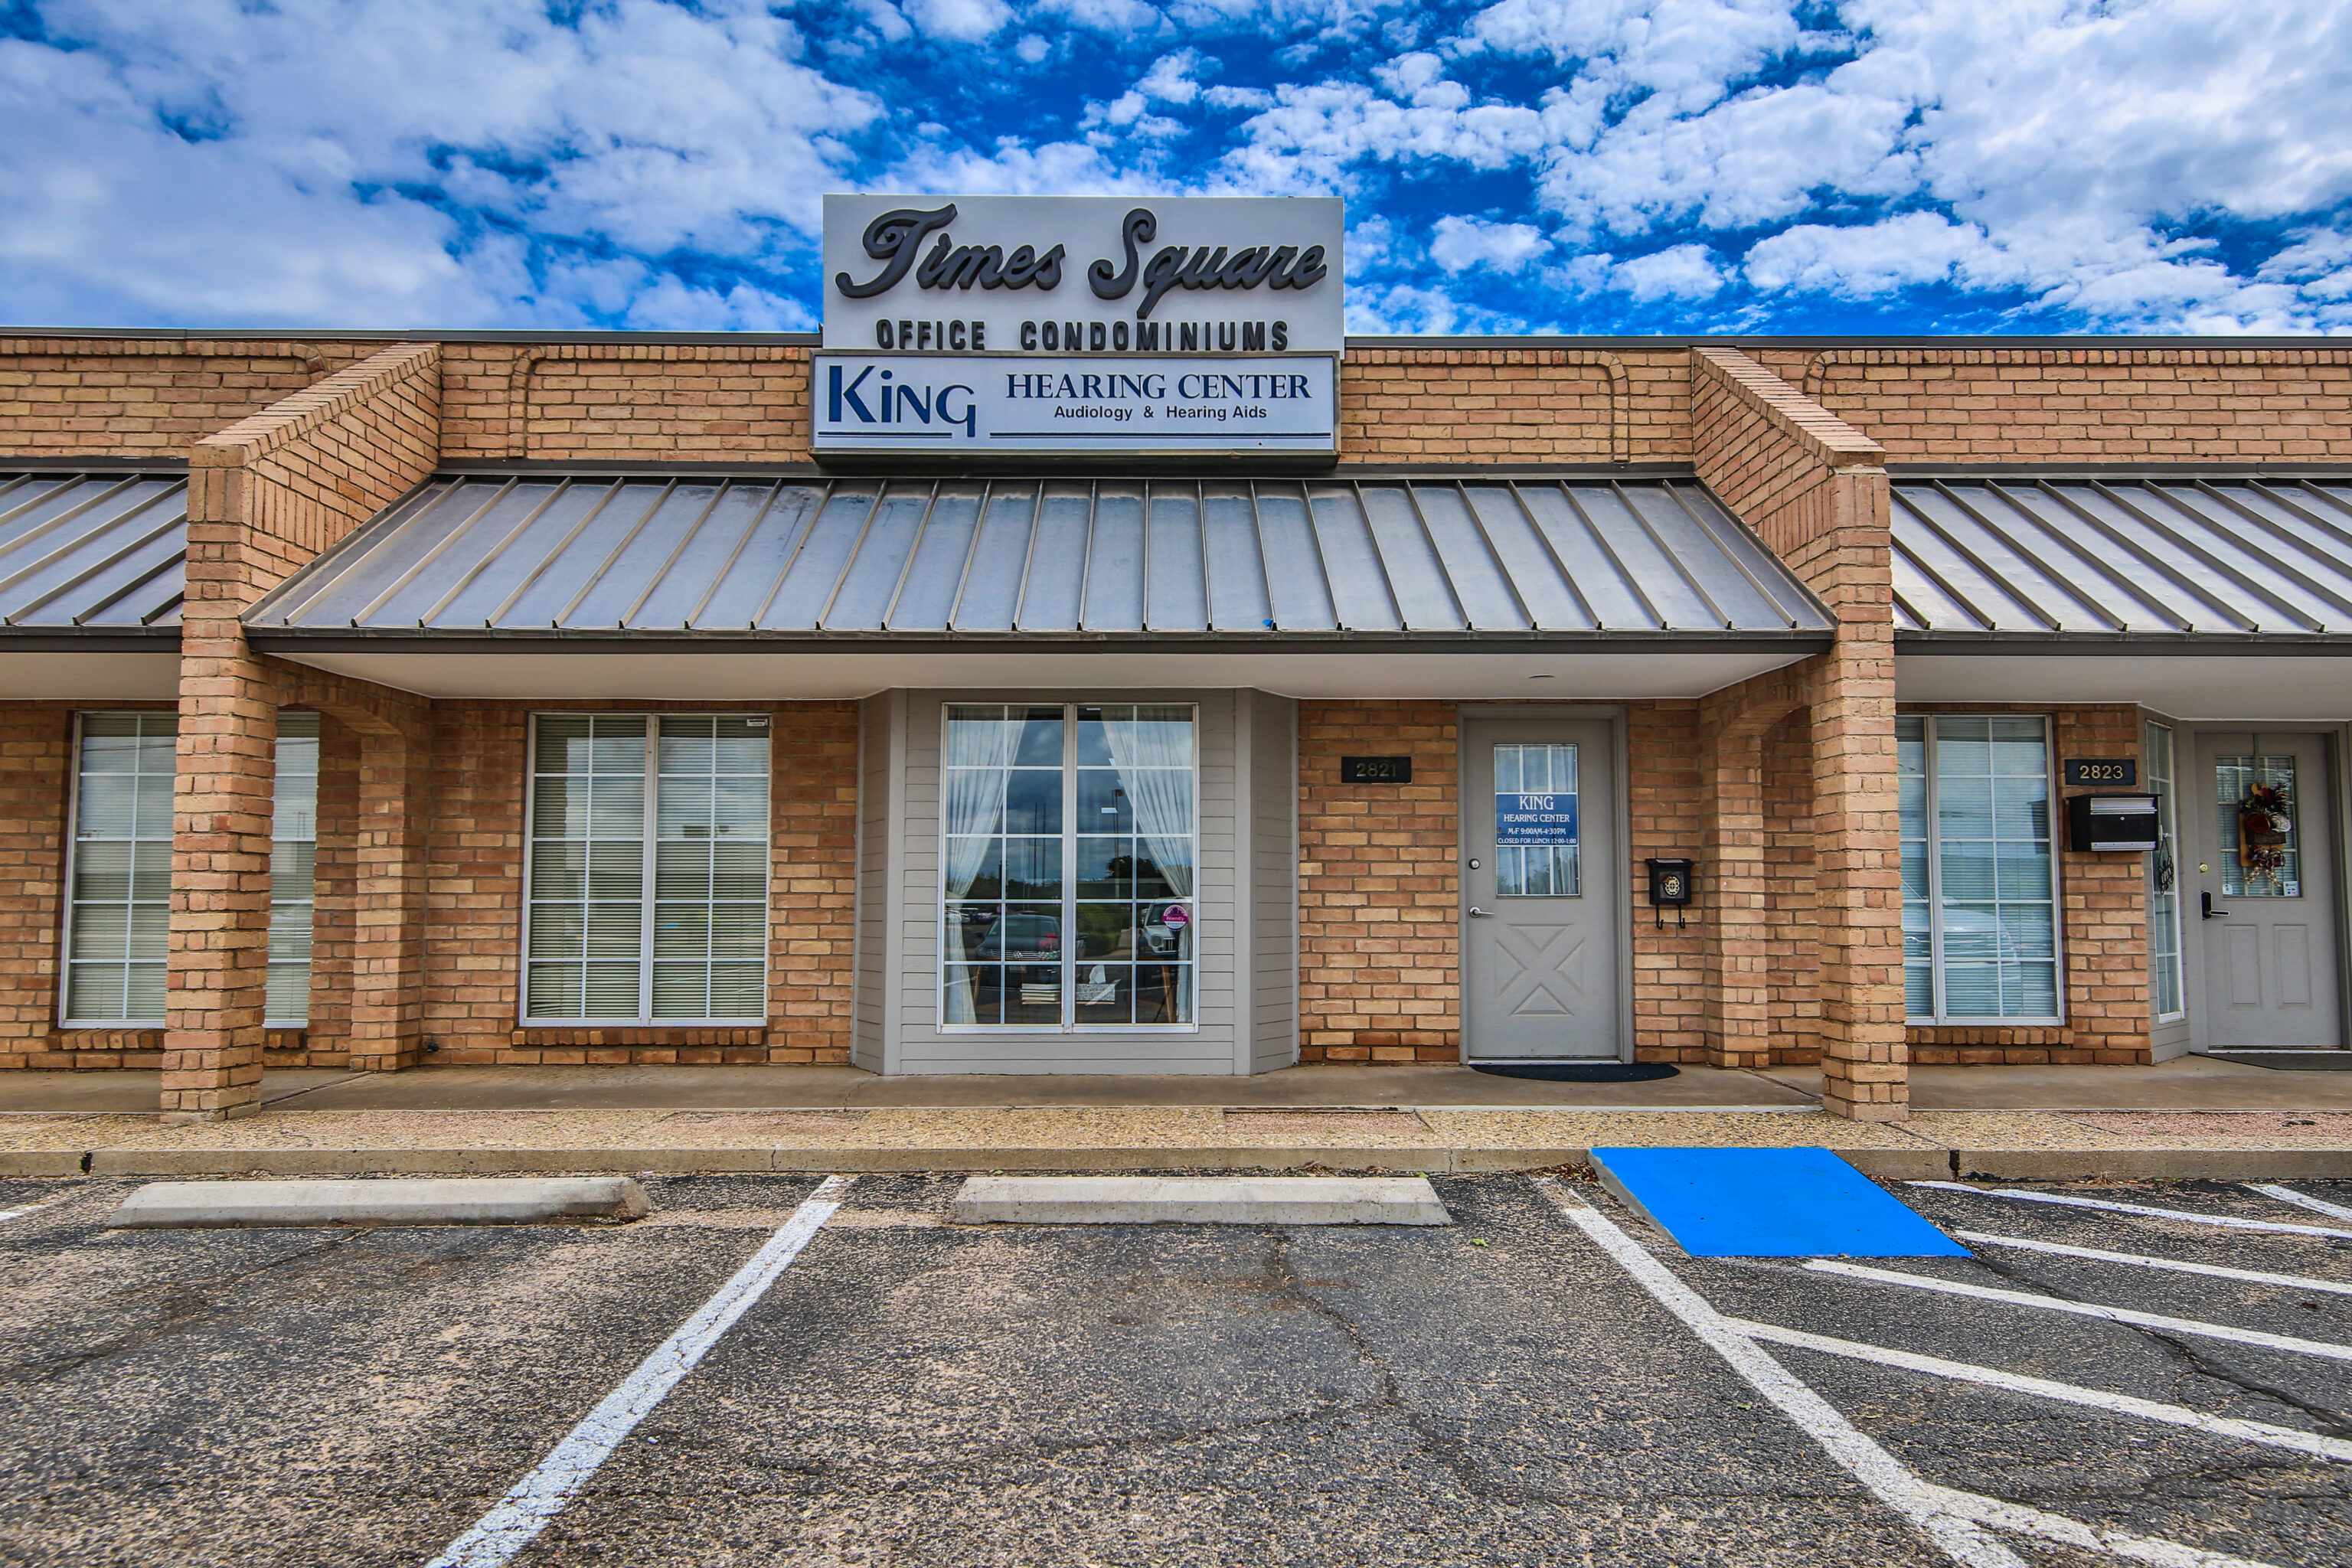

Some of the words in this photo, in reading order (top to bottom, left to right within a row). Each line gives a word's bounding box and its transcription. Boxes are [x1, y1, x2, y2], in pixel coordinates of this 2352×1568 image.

[835, 203, 1066, 299] Times
[1087, 207, 1328, 319] Square
[875, 318, 985, 350] OFFICE
[1020, 320, 1289, 351] CONDOMINIUMS
[1005, 373, 1167, 400] HEARING
[1178, 373, 1313, 400] CENTER
[1054, 405, 1133, 422] Audiology
[1143, 406, 1155, 419] &
[1166, 405, 1227, 422] Hearing
[1232, 405, 1268, 419] Aids
[1356, 763, 1396, 777] 2821
[2079, 765, 2124, 779] 2823
[1519, 795, 1554, 810] KING
[1504, 814, 1537, 822] HEARING
[1540, 814, 1570, 822] CENTER
